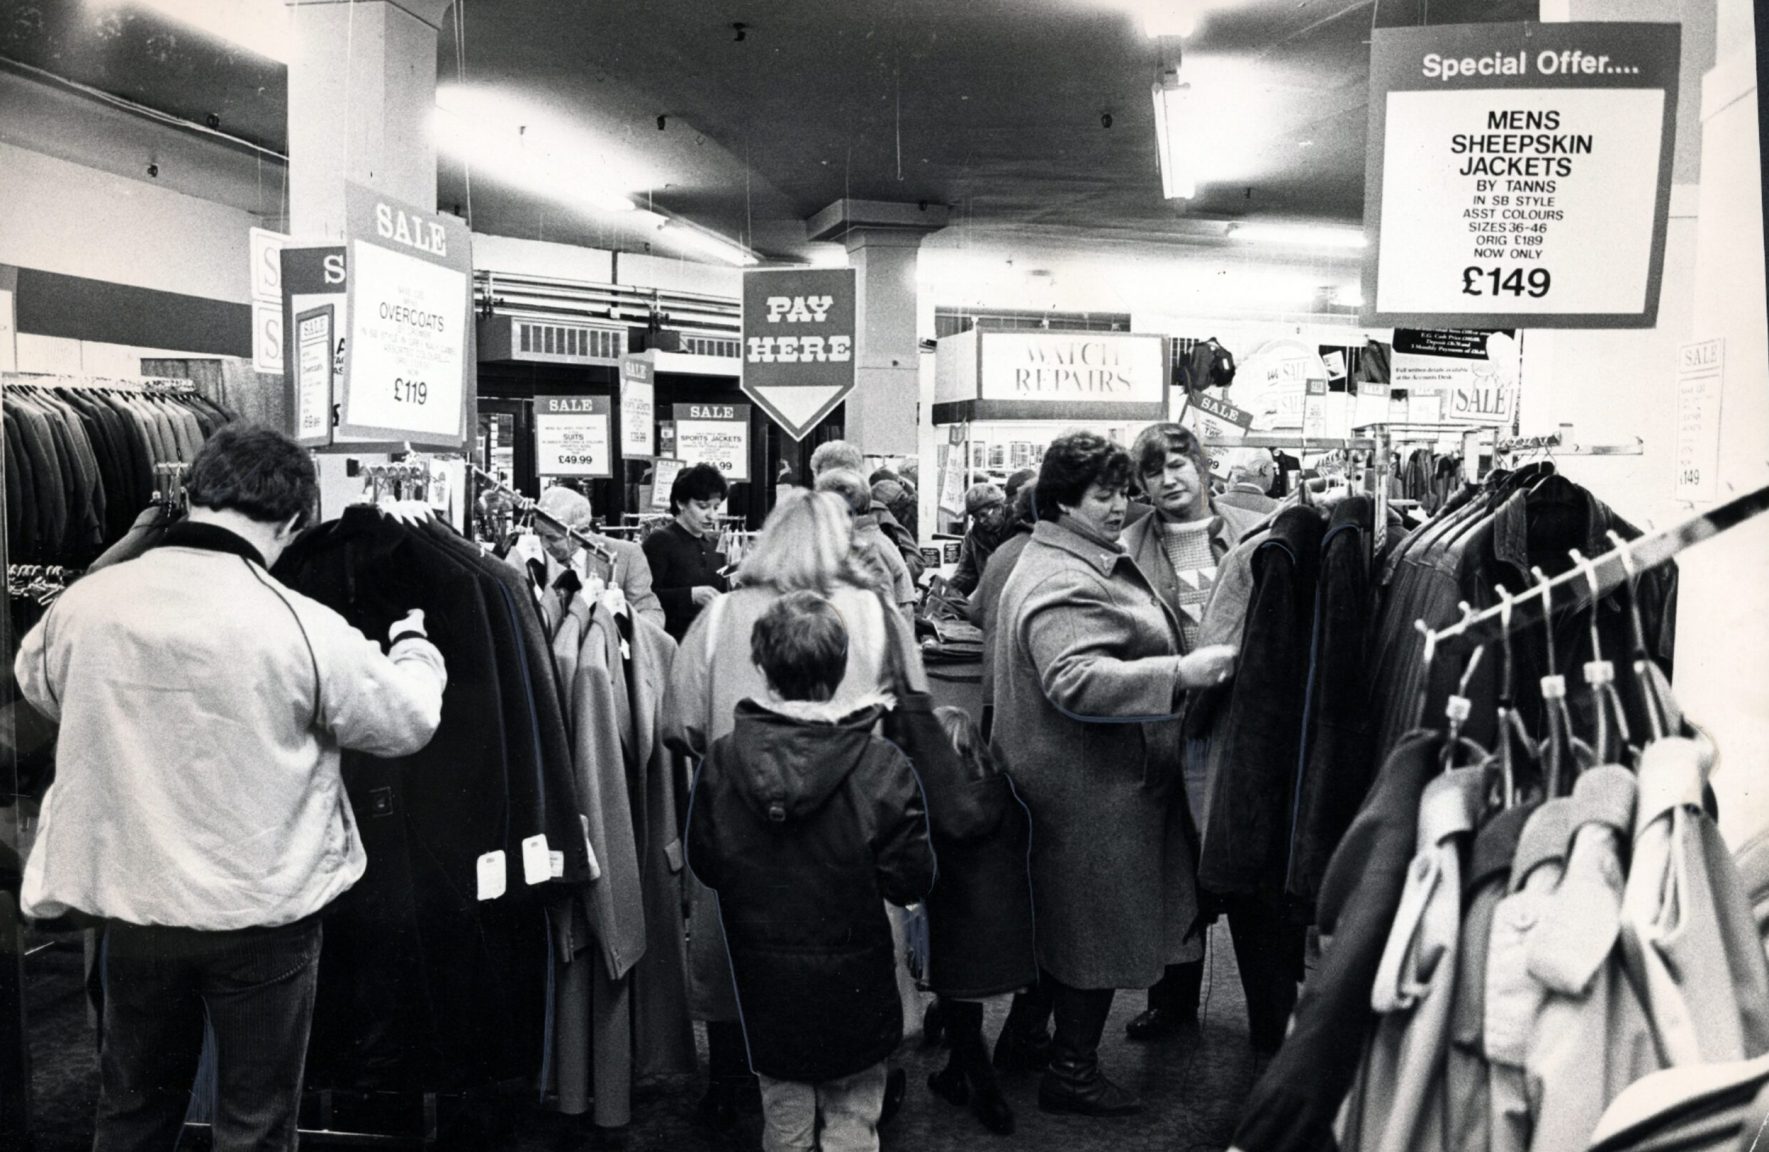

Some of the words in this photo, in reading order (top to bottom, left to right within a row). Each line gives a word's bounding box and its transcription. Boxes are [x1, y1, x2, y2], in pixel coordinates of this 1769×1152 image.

[1422, 51, 1526, 81] Special
[1487, 110, 1561, 130] MENS
[1450, 134, 1593, 155] SHEEPSKIN
[1459, 156, 1572, 177] JACKETS
[1476, 179, 1497, 193] BY
[1506, 180, 1556, 194] TANNS
[1473, 195, 1486, 206] IN
[1491, 196, 1509, 206] SB
[1516, 196, 1555, 207] STYLE
[1463, 208, 1496, 219] ASST
[1502, 209, 1564, 220] COLOURS
[377, 203, 447, 257] SALE
[1468, 222, 1506, 233] SIZES
[1508, 222, 1547, 234] 36-46
[1476, 235, 1507, 246] ORIG
[1514, 235, 1543, 246] £189
[1474, 248, 1505, 259] NOW
[1510, 248, 1543, 260] ONLY
[1462, 266, 1551, 298] £149
[379, 301, 445, 333] OVERCOATS
[766, 295, 834, 323] PAY
[747, 335, 852, 363] HERE
[1026, 342, 1120, 366] WATCH
[1684, 344, 1718, 367] SALE
[625, 361, 647, 380] SALE
[1015, 368, 1132, 393] REPAIRS
[393, 377, 428, 406] £119
[1456, 388, 1505, 415] SALE
[549, 399, 593, 412] SALE
[690, 406, 734, 418] SALE
[1201, 397, 1239, 422] SALE
[563, 433, 584, 441] SUITS
[711, 435, 742, 443] JACKETS
[558, 455, 593, 465] £49.99
